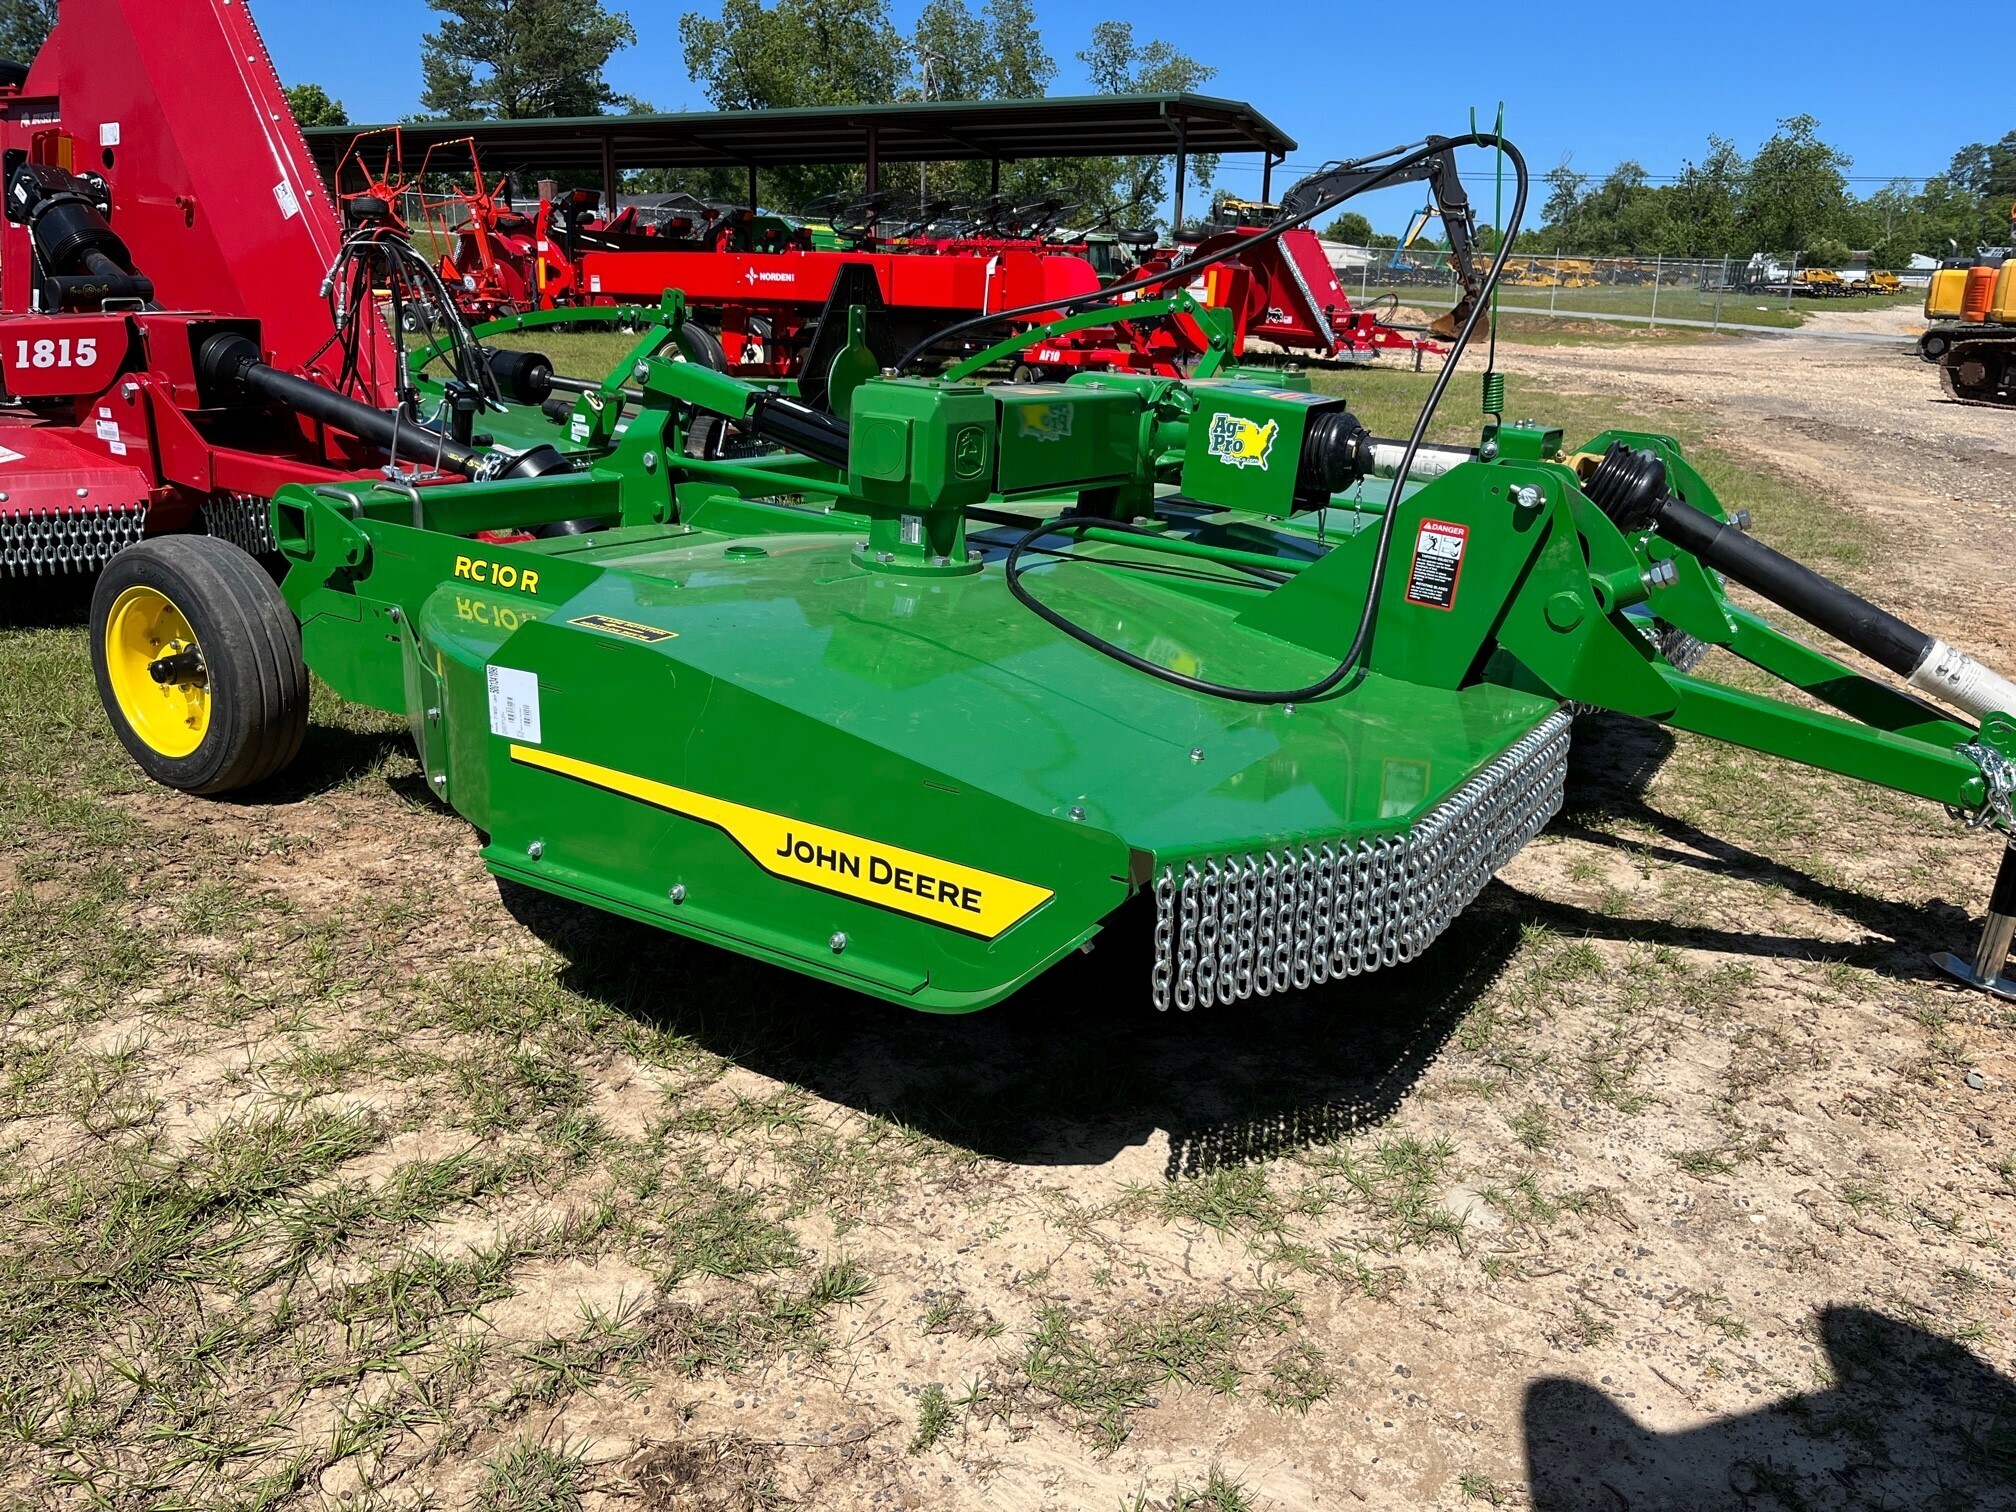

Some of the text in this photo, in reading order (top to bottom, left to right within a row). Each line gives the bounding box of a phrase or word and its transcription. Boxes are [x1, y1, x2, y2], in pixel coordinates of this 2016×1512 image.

[760, 272, 792, 281] NORDEN
[16, 338, 97, 368] 1815
[1039, 350, 1060, 362] AF10
[1212, 434, 1243, 453] Pro
[1431, 523, 1465, 536] DANGER
[454, 555, 540, 595] RC 10 R
[776, 832, 983, 914] JOHN DEERE
